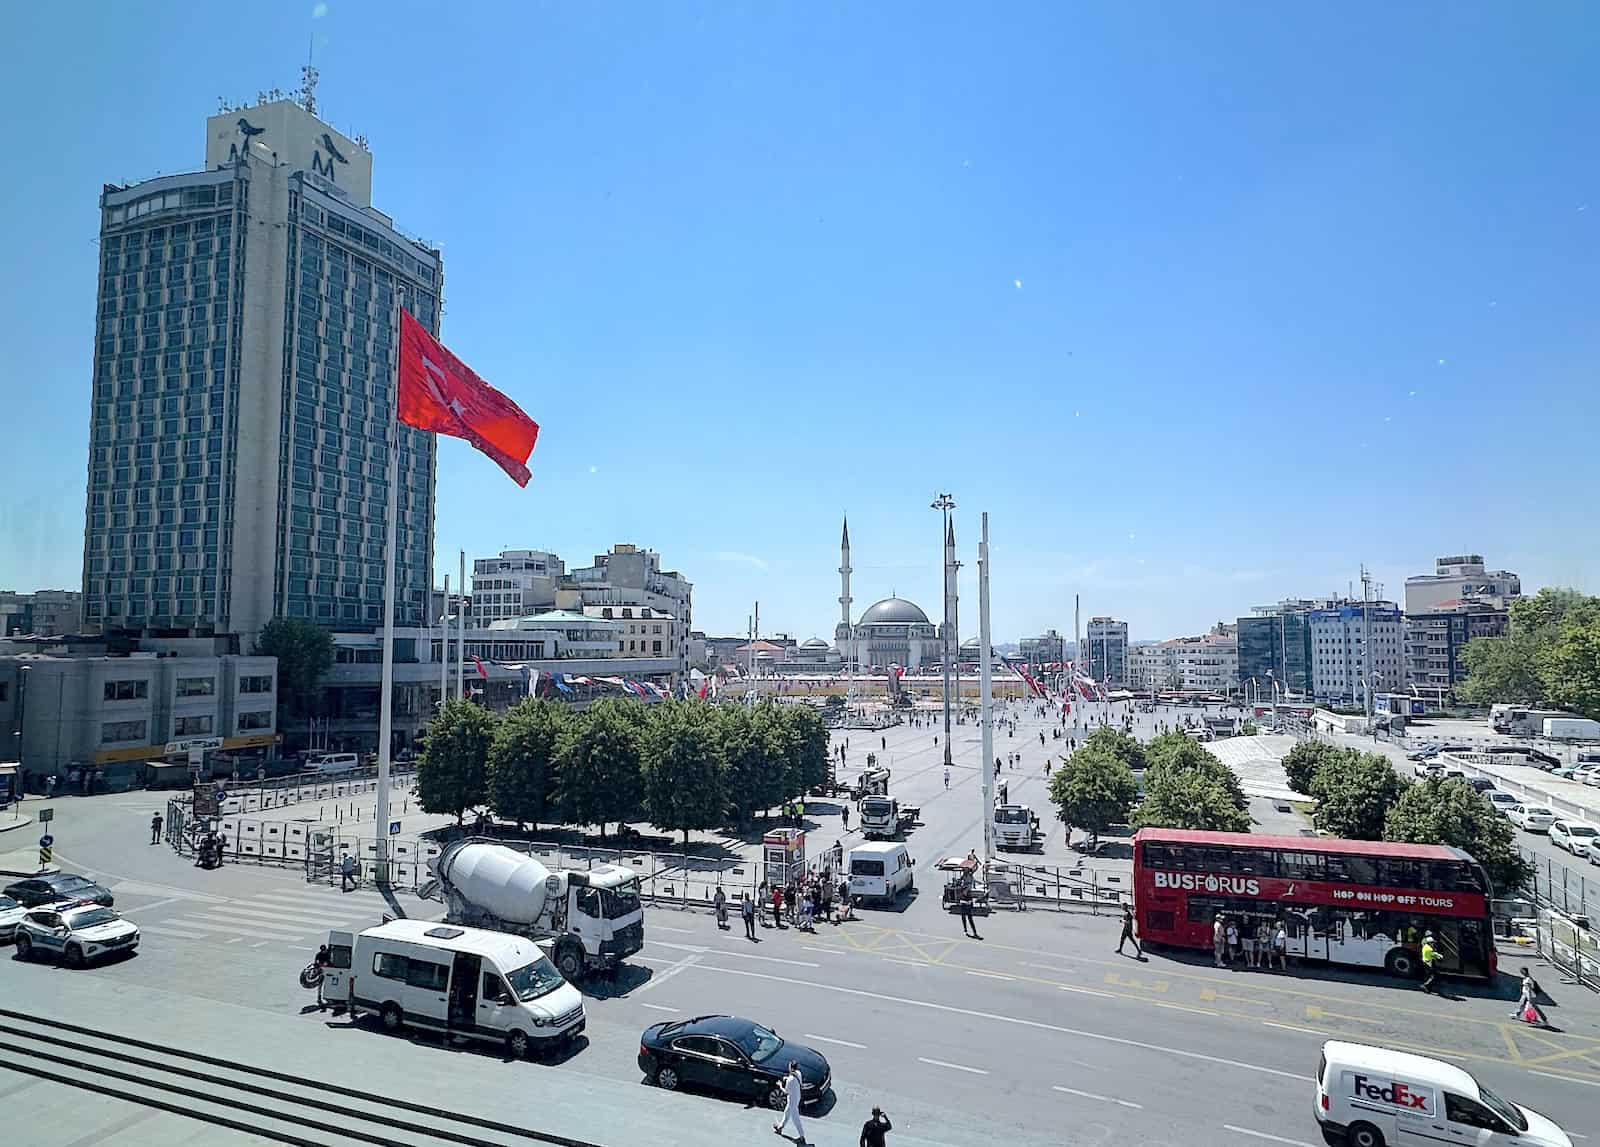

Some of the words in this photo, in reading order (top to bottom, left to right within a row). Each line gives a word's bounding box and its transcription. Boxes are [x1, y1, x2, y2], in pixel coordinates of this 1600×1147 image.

[312, 150, 335, 181] M
[1154, 871, 1260, 896] BUSFORUS
[1333, 890, 1355, 899] HOP
[1356, 891, 1372, 901] ON
[1373, 893, 1396, 903] HOP
[1397, 895, 1417, 905] OFF
[1418, 896, 1454, 908] TOURS
[1354, 1074, 1428, 1111] FedEx
